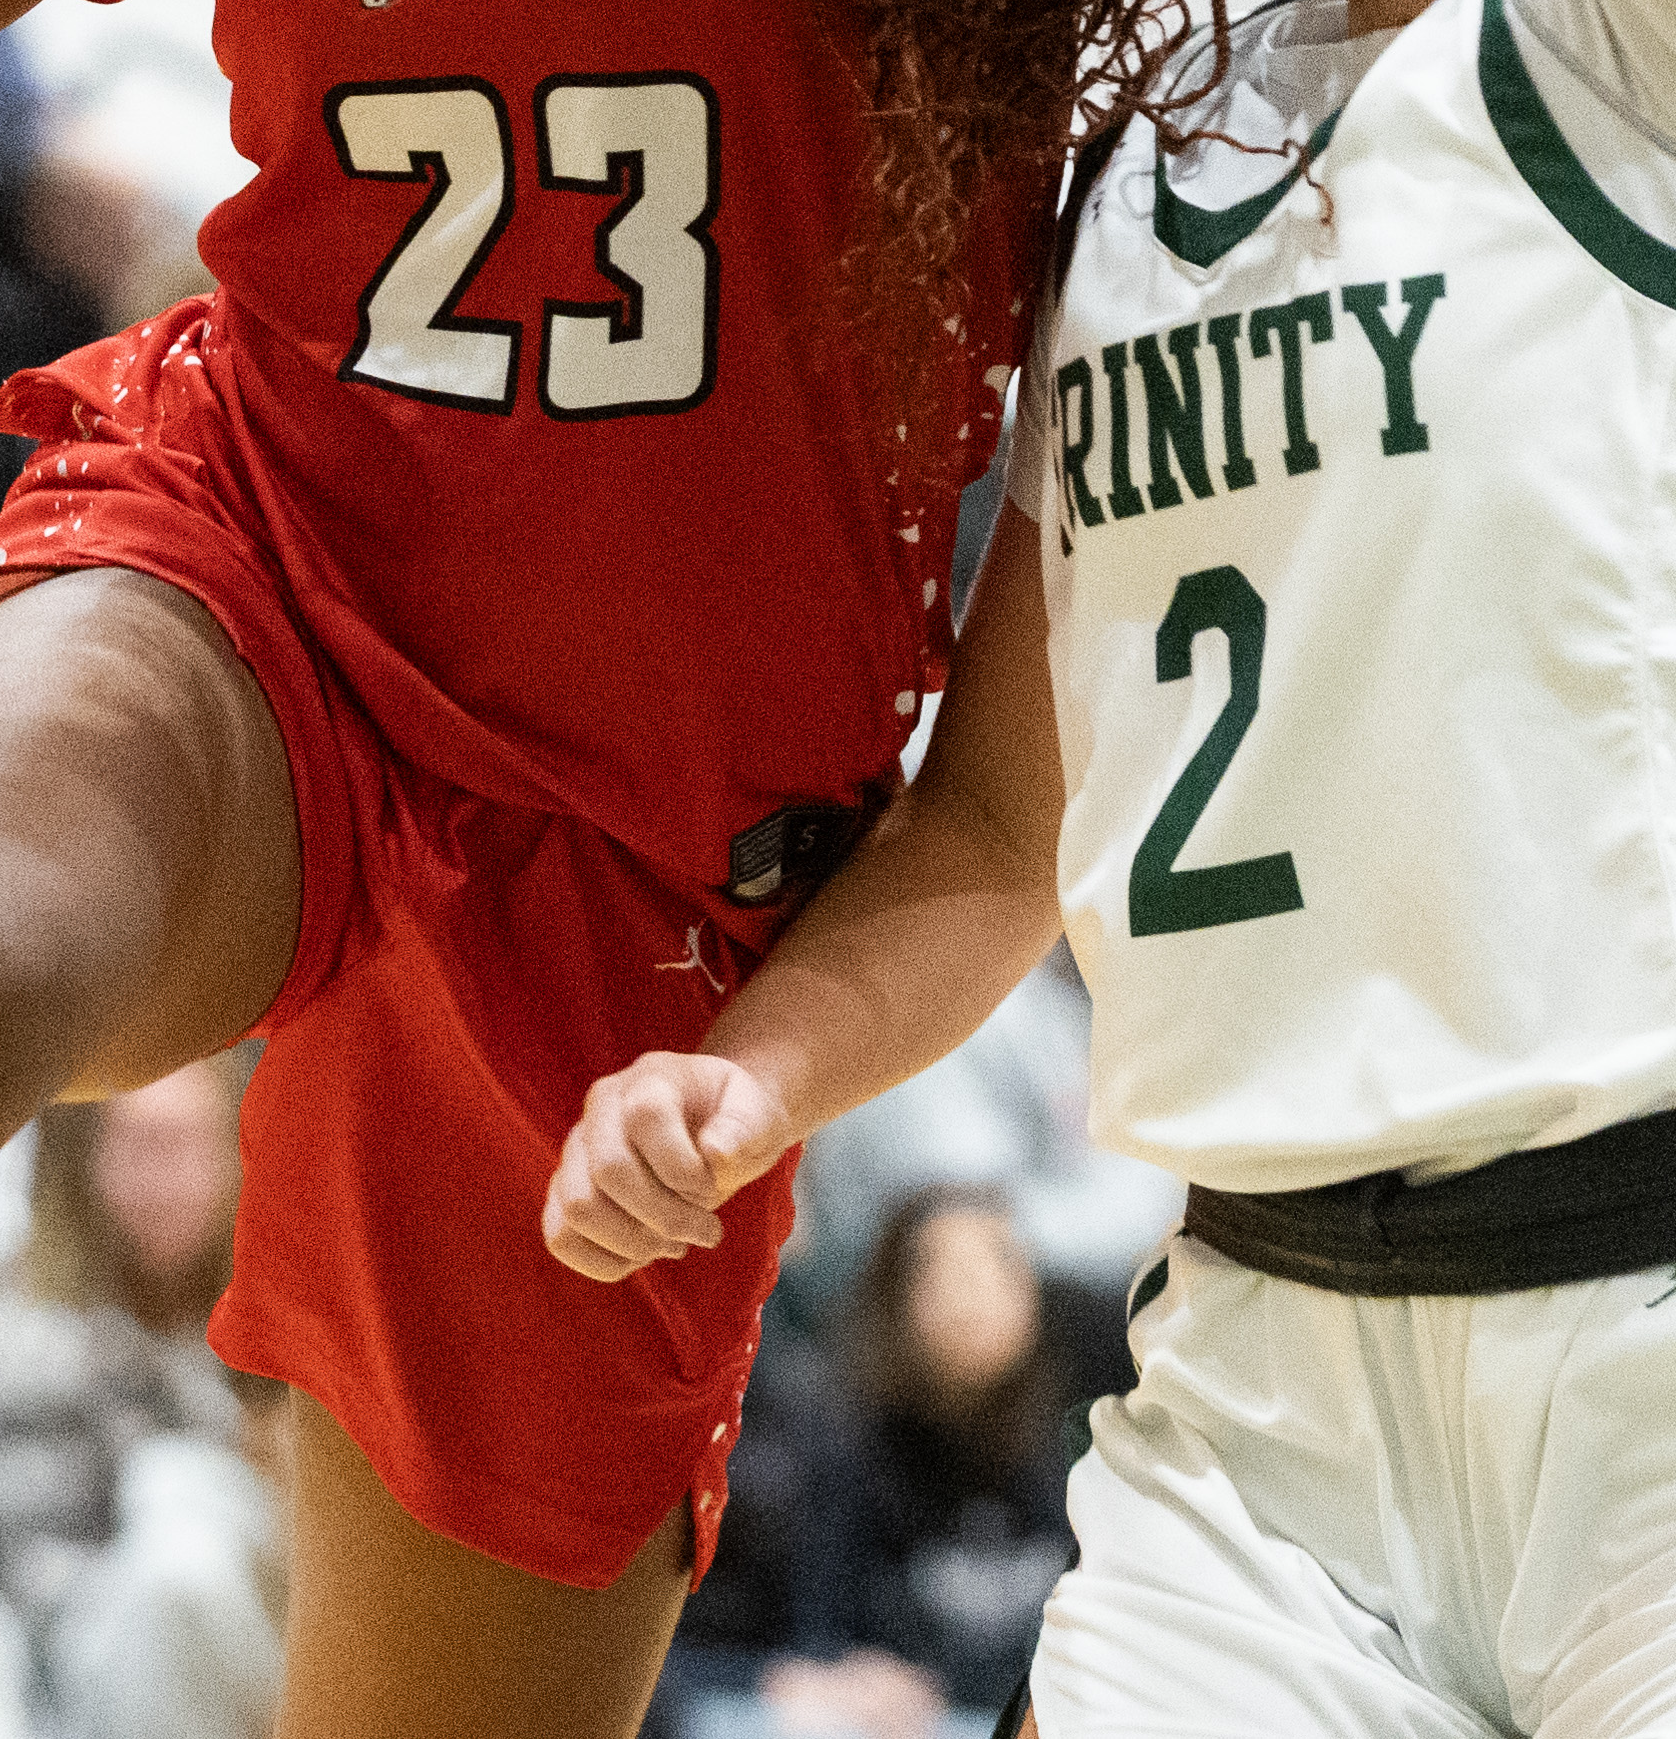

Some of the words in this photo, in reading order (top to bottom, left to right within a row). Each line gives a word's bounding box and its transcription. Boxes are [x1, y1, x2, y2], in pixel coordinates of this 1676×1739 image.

[325, 70, 720, 422] 23
[1051, 272, 1446, 558] RINITY
[1129, 564, 1304, 938] 2
